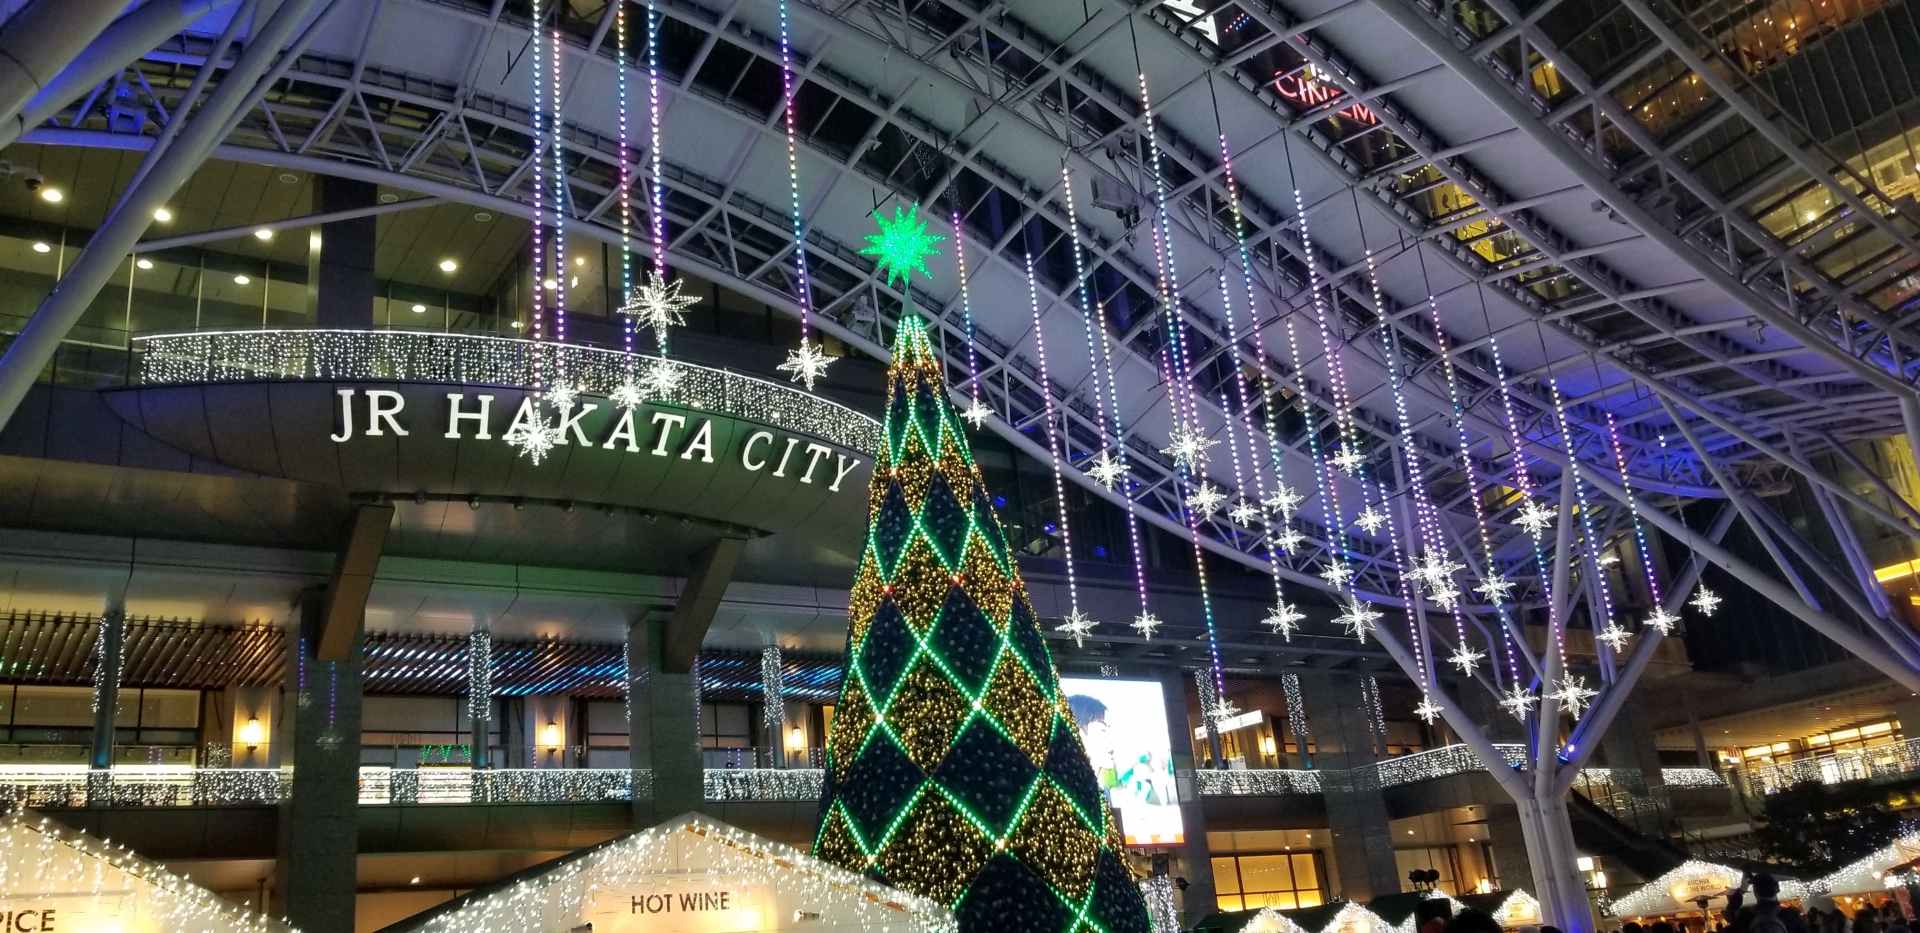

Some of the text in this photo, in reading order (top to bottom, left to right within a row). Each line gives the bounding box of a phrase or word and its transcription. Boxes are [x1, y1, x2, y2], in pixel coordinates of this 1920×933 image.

[331, 389, 861, 492] JR HAKATA CITY
[1689, 885, 1699, 893] THE
[1699, 883, 1722, 892] WORLD
[631, 892, 729, 914] HOT WINE
